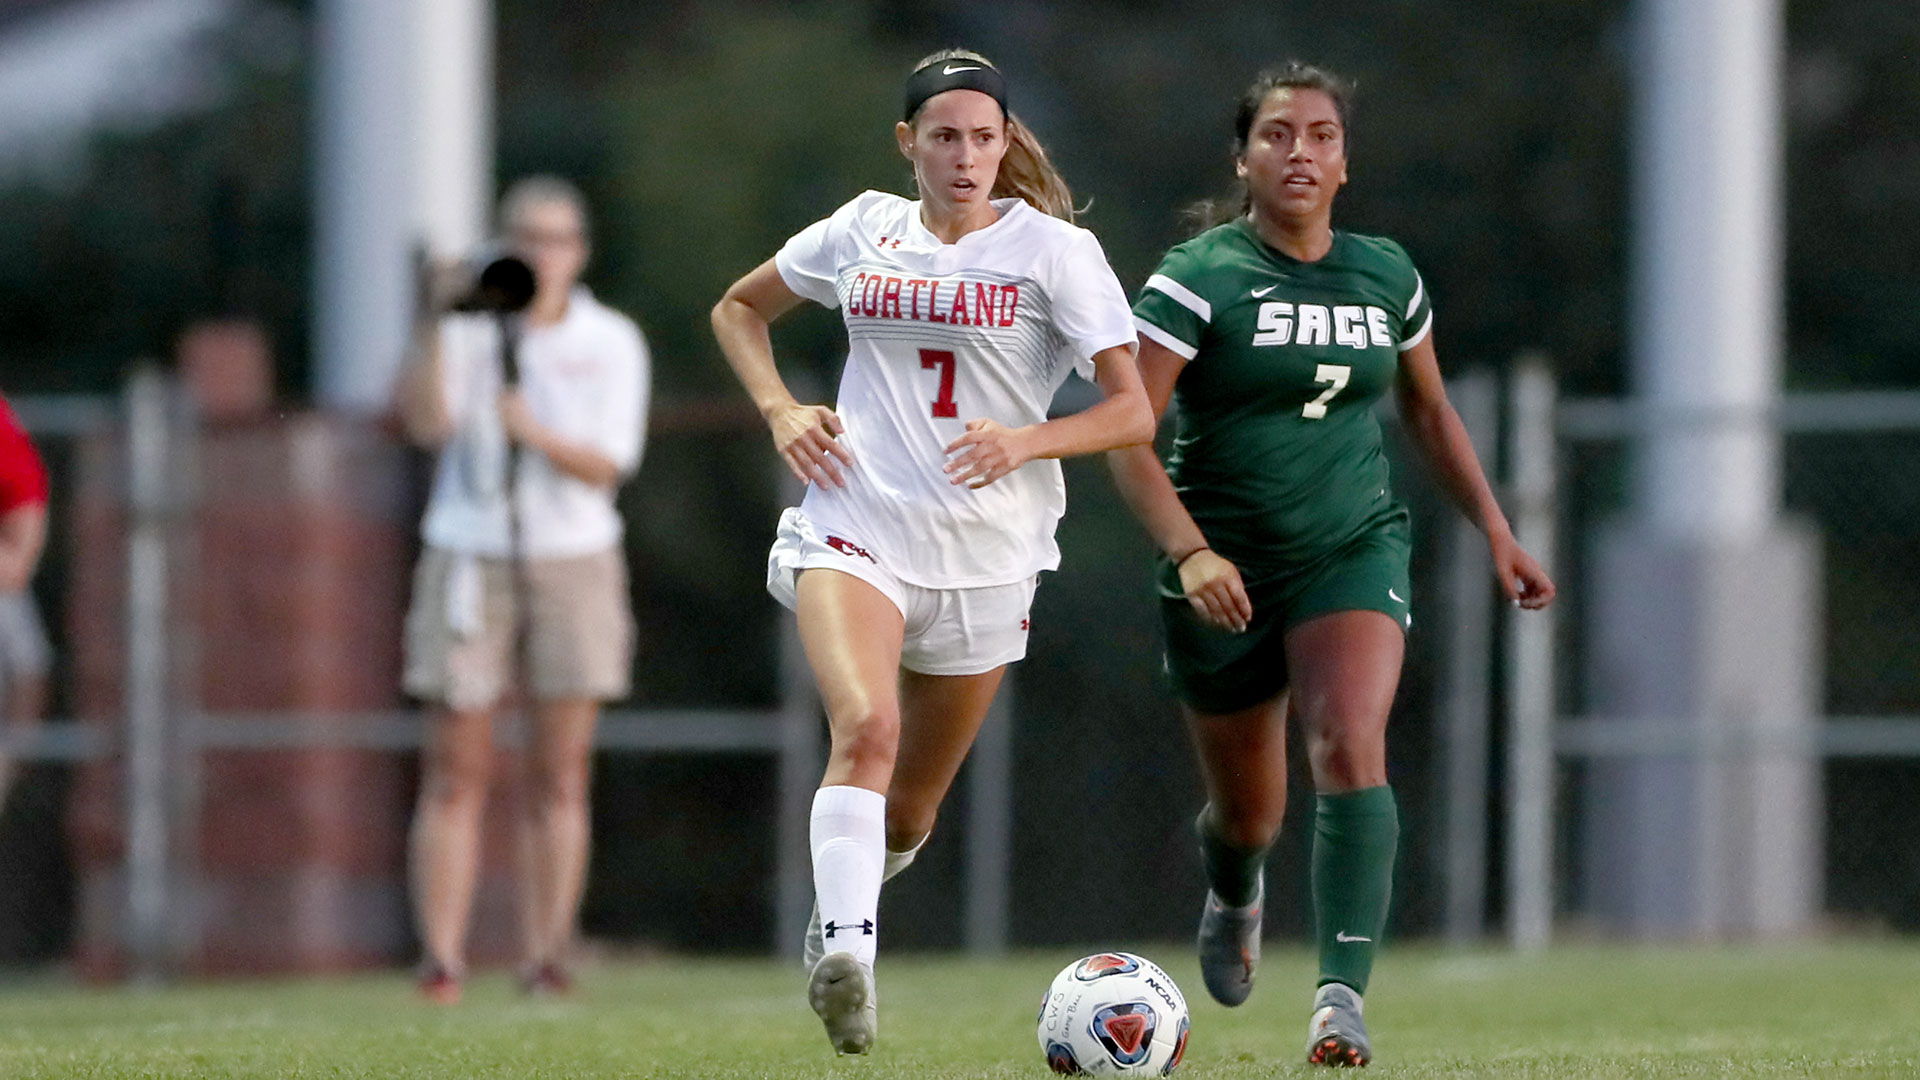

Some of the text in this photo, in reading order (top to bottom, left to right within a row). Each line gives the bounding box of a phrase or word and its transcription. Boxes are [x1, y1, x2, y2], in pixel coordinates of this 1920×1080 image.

[849, 272, 1018, 327] CORTLAND
[1252, 301, 1392, 349] SAGE
[917, 348, 959, 418] 7
[1301, 363, 1352, 419] 7
[1046, 992, 1065, 1031] CWS
[1145, 977, 1176, 1011] NCAA
